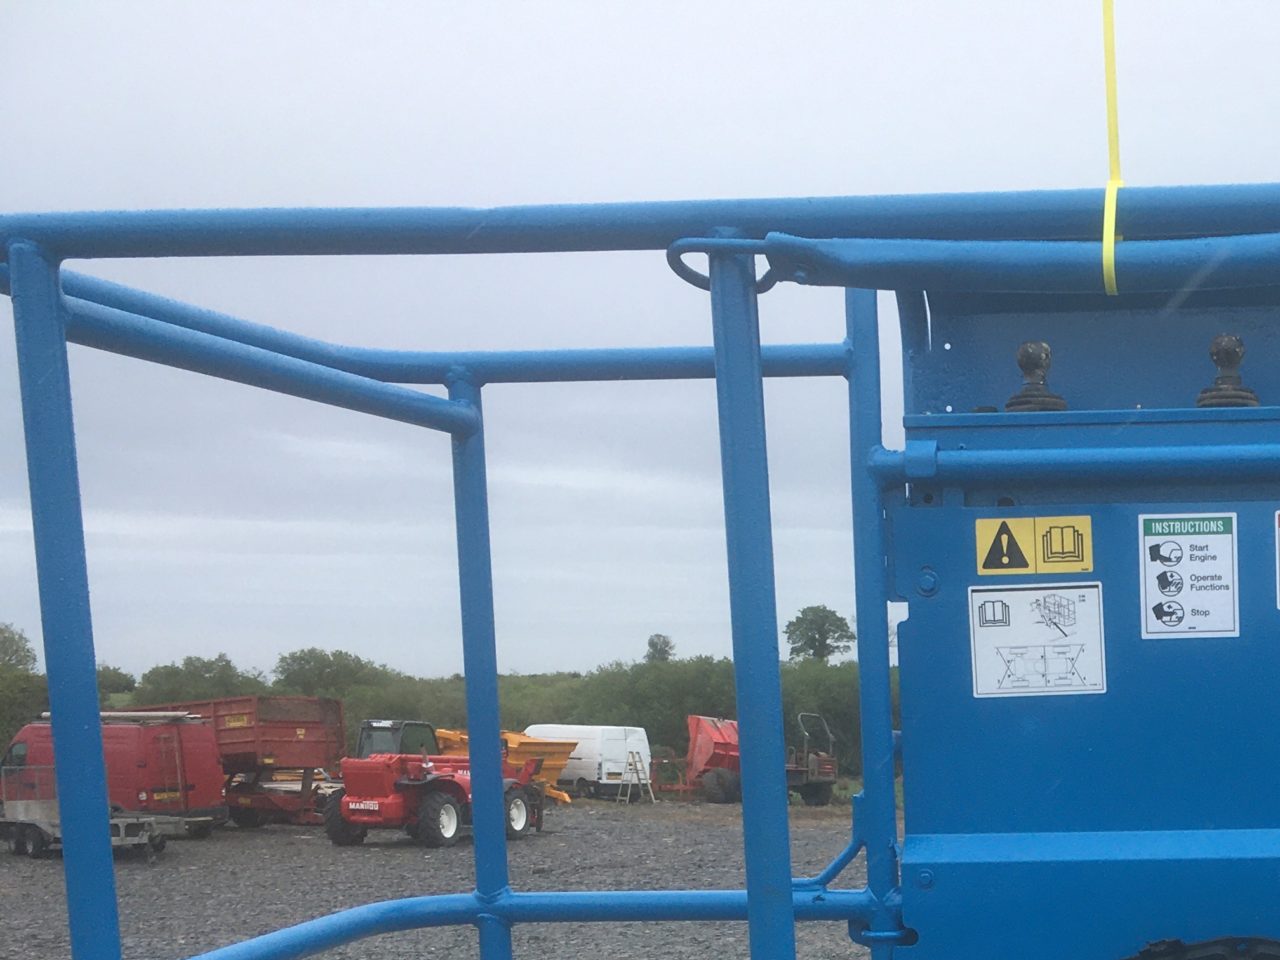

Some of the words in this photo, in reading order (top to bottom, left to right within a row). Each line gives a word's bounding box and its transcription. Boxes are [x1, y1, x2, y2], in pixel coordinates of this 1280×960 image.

[1152, 520, 1224, 534] INSTRUCTIONS
[1189, 544, 1209, 552] Start
[1189, 554, 1217, 562] Engine
[1189, 574, 1223, 582] Operate
[1190, 583, 1230, 591] Functions
[1190, 608, 1210, 617] Stop
